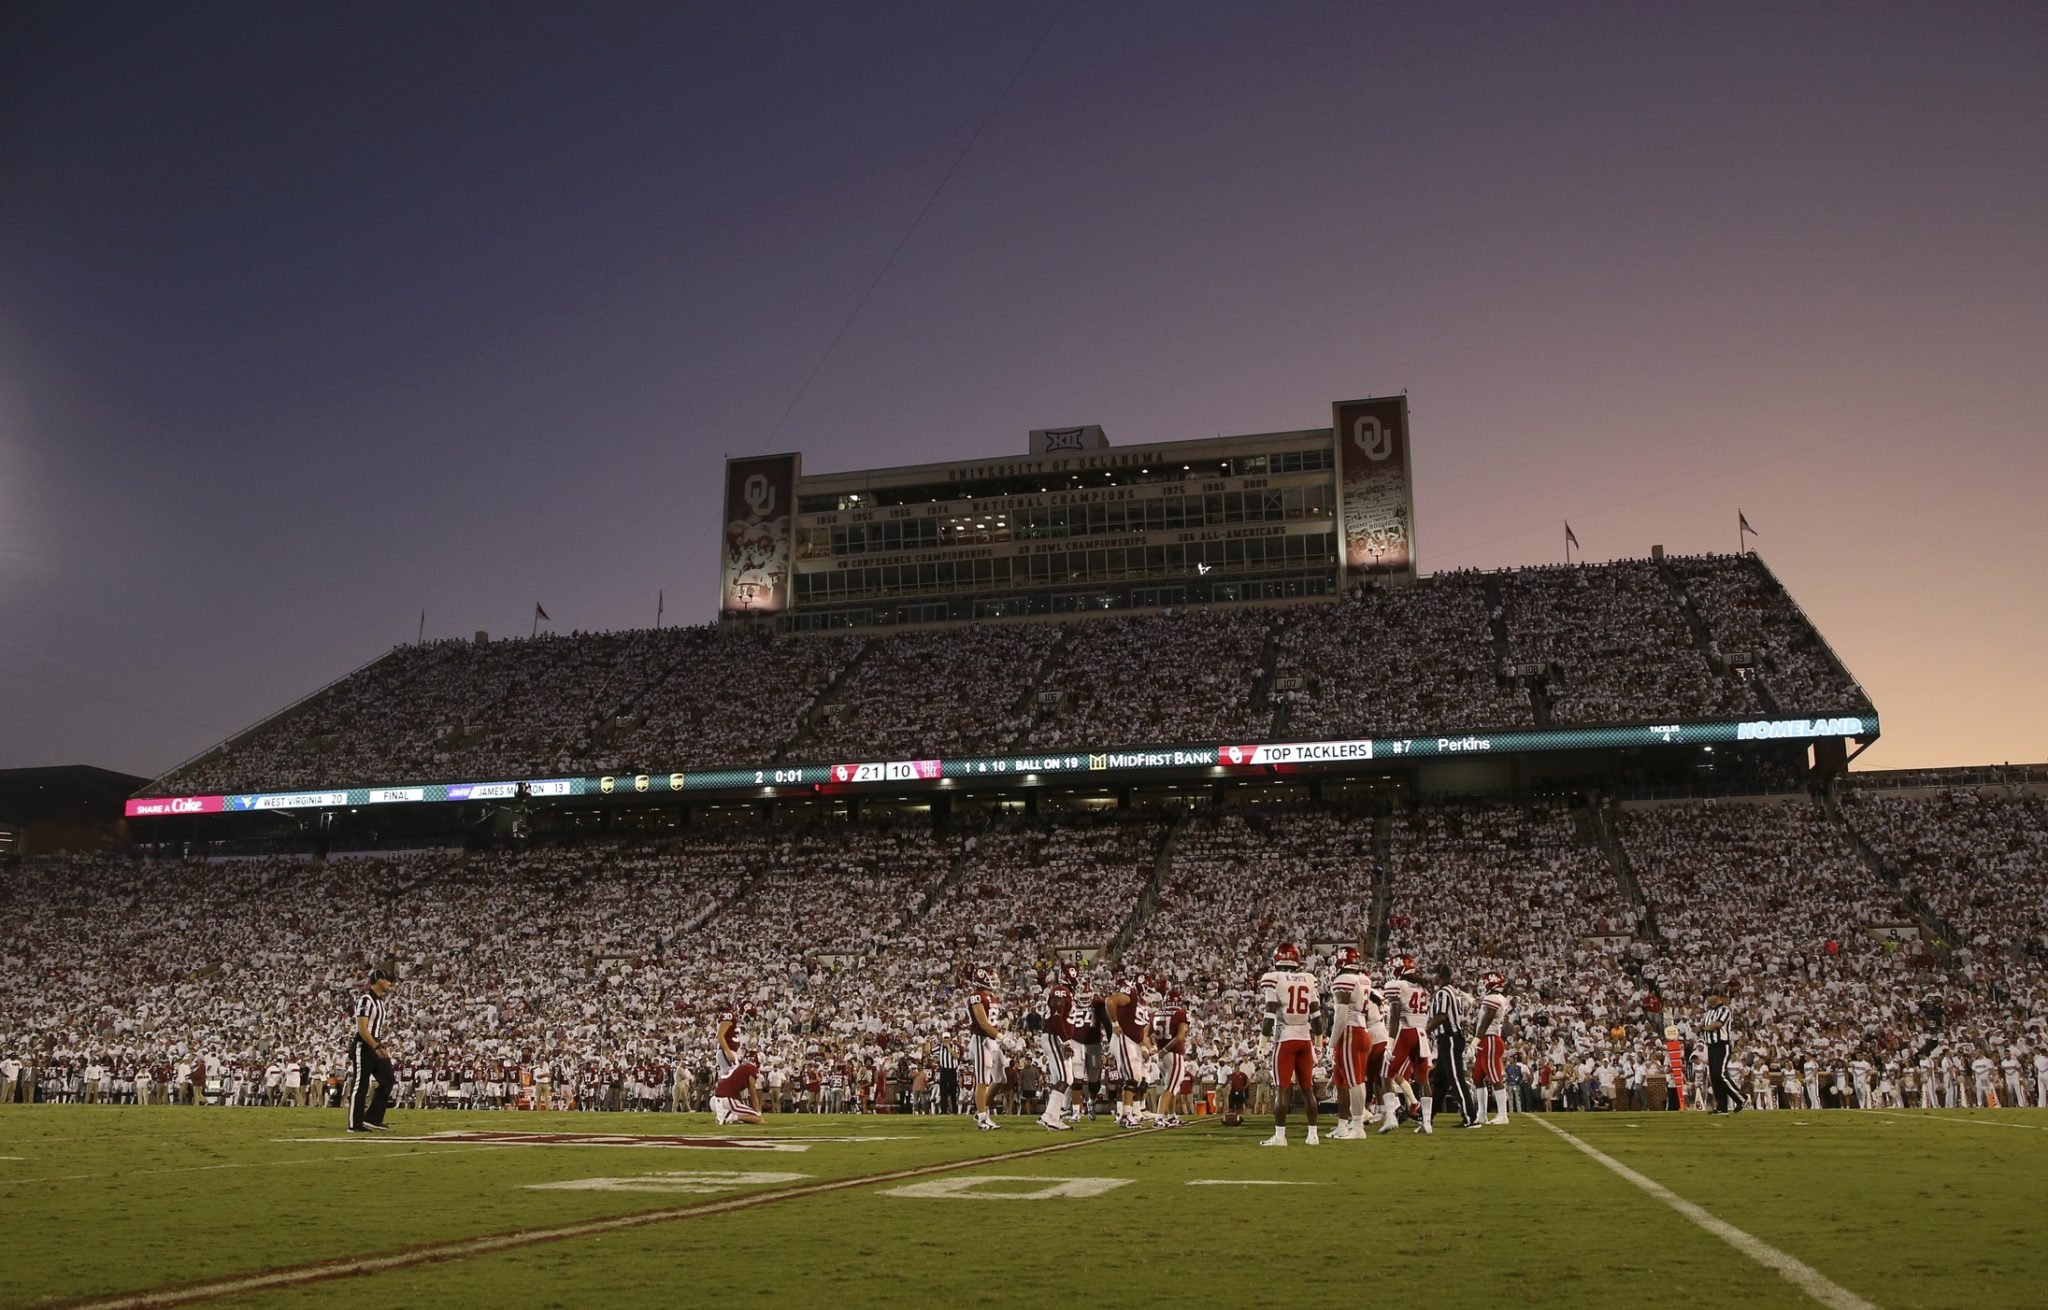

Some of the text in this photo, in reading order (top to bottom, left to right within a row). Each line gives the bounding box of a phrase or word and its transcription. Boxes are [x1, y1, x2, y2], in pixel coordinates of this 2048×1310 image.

[1353, 415, 1392, 461] OU
[949, 451, 1164, 481] UNIVERSITY OF OKLAHOMA
[744, 473, 776, 516] OU
[1163, 485, 1186, 495] 1975
[1244, 479, 1268, 489] 2000
[972, 489, 1135, 512] NATIONAL CHAMPIONS
[927, 505, 949, 515] 1974
[1200, 526, 1287, 540] ALL-AMERICANS
[1035, 543, 1062, 553] BOWL
[1065, 537, 1147, 551] CHAMPIONSHIPS
[852, 555, 912, 567] CONFERENCE
[914, 548, 993, 563] CHAMPIONSHIPS
[1283, 679, 1297, 688] 107
[1044, 693, 1057, 702] 106
[1649, 725, 1680, 742] TACKLES 4
[1737, 717, 1863, 739] HOMELAND
[1265, 744, 1367, 760] TOP TACKLERS
[1392, 737, 1491, 754] #7 Perkins
[861, 766, 880, 780] 21
[892, 764, 911, 778] 10
[965, 757, 1079, 773] 1 & 10 BALL ON 19
[755, 770, 802, 783] 2 0:01
[384, 790, 409, 800] FINAL
[478, 786, 505, 796] JAMES
[554, 783, 564, 793] 13
[136, 798, 203, 814] SHARE A Coke
[263, 794, 343, 807] WEST VIRGINIA 20
[1287, 985, 1309, 1015] 16
[1408, 991, 1429, 1014] 42
[722, 1012, 733, 1021] 30
[1074, 1010, 1095, 1028] 54
[1152, 1016, 1173, 1039] 51
